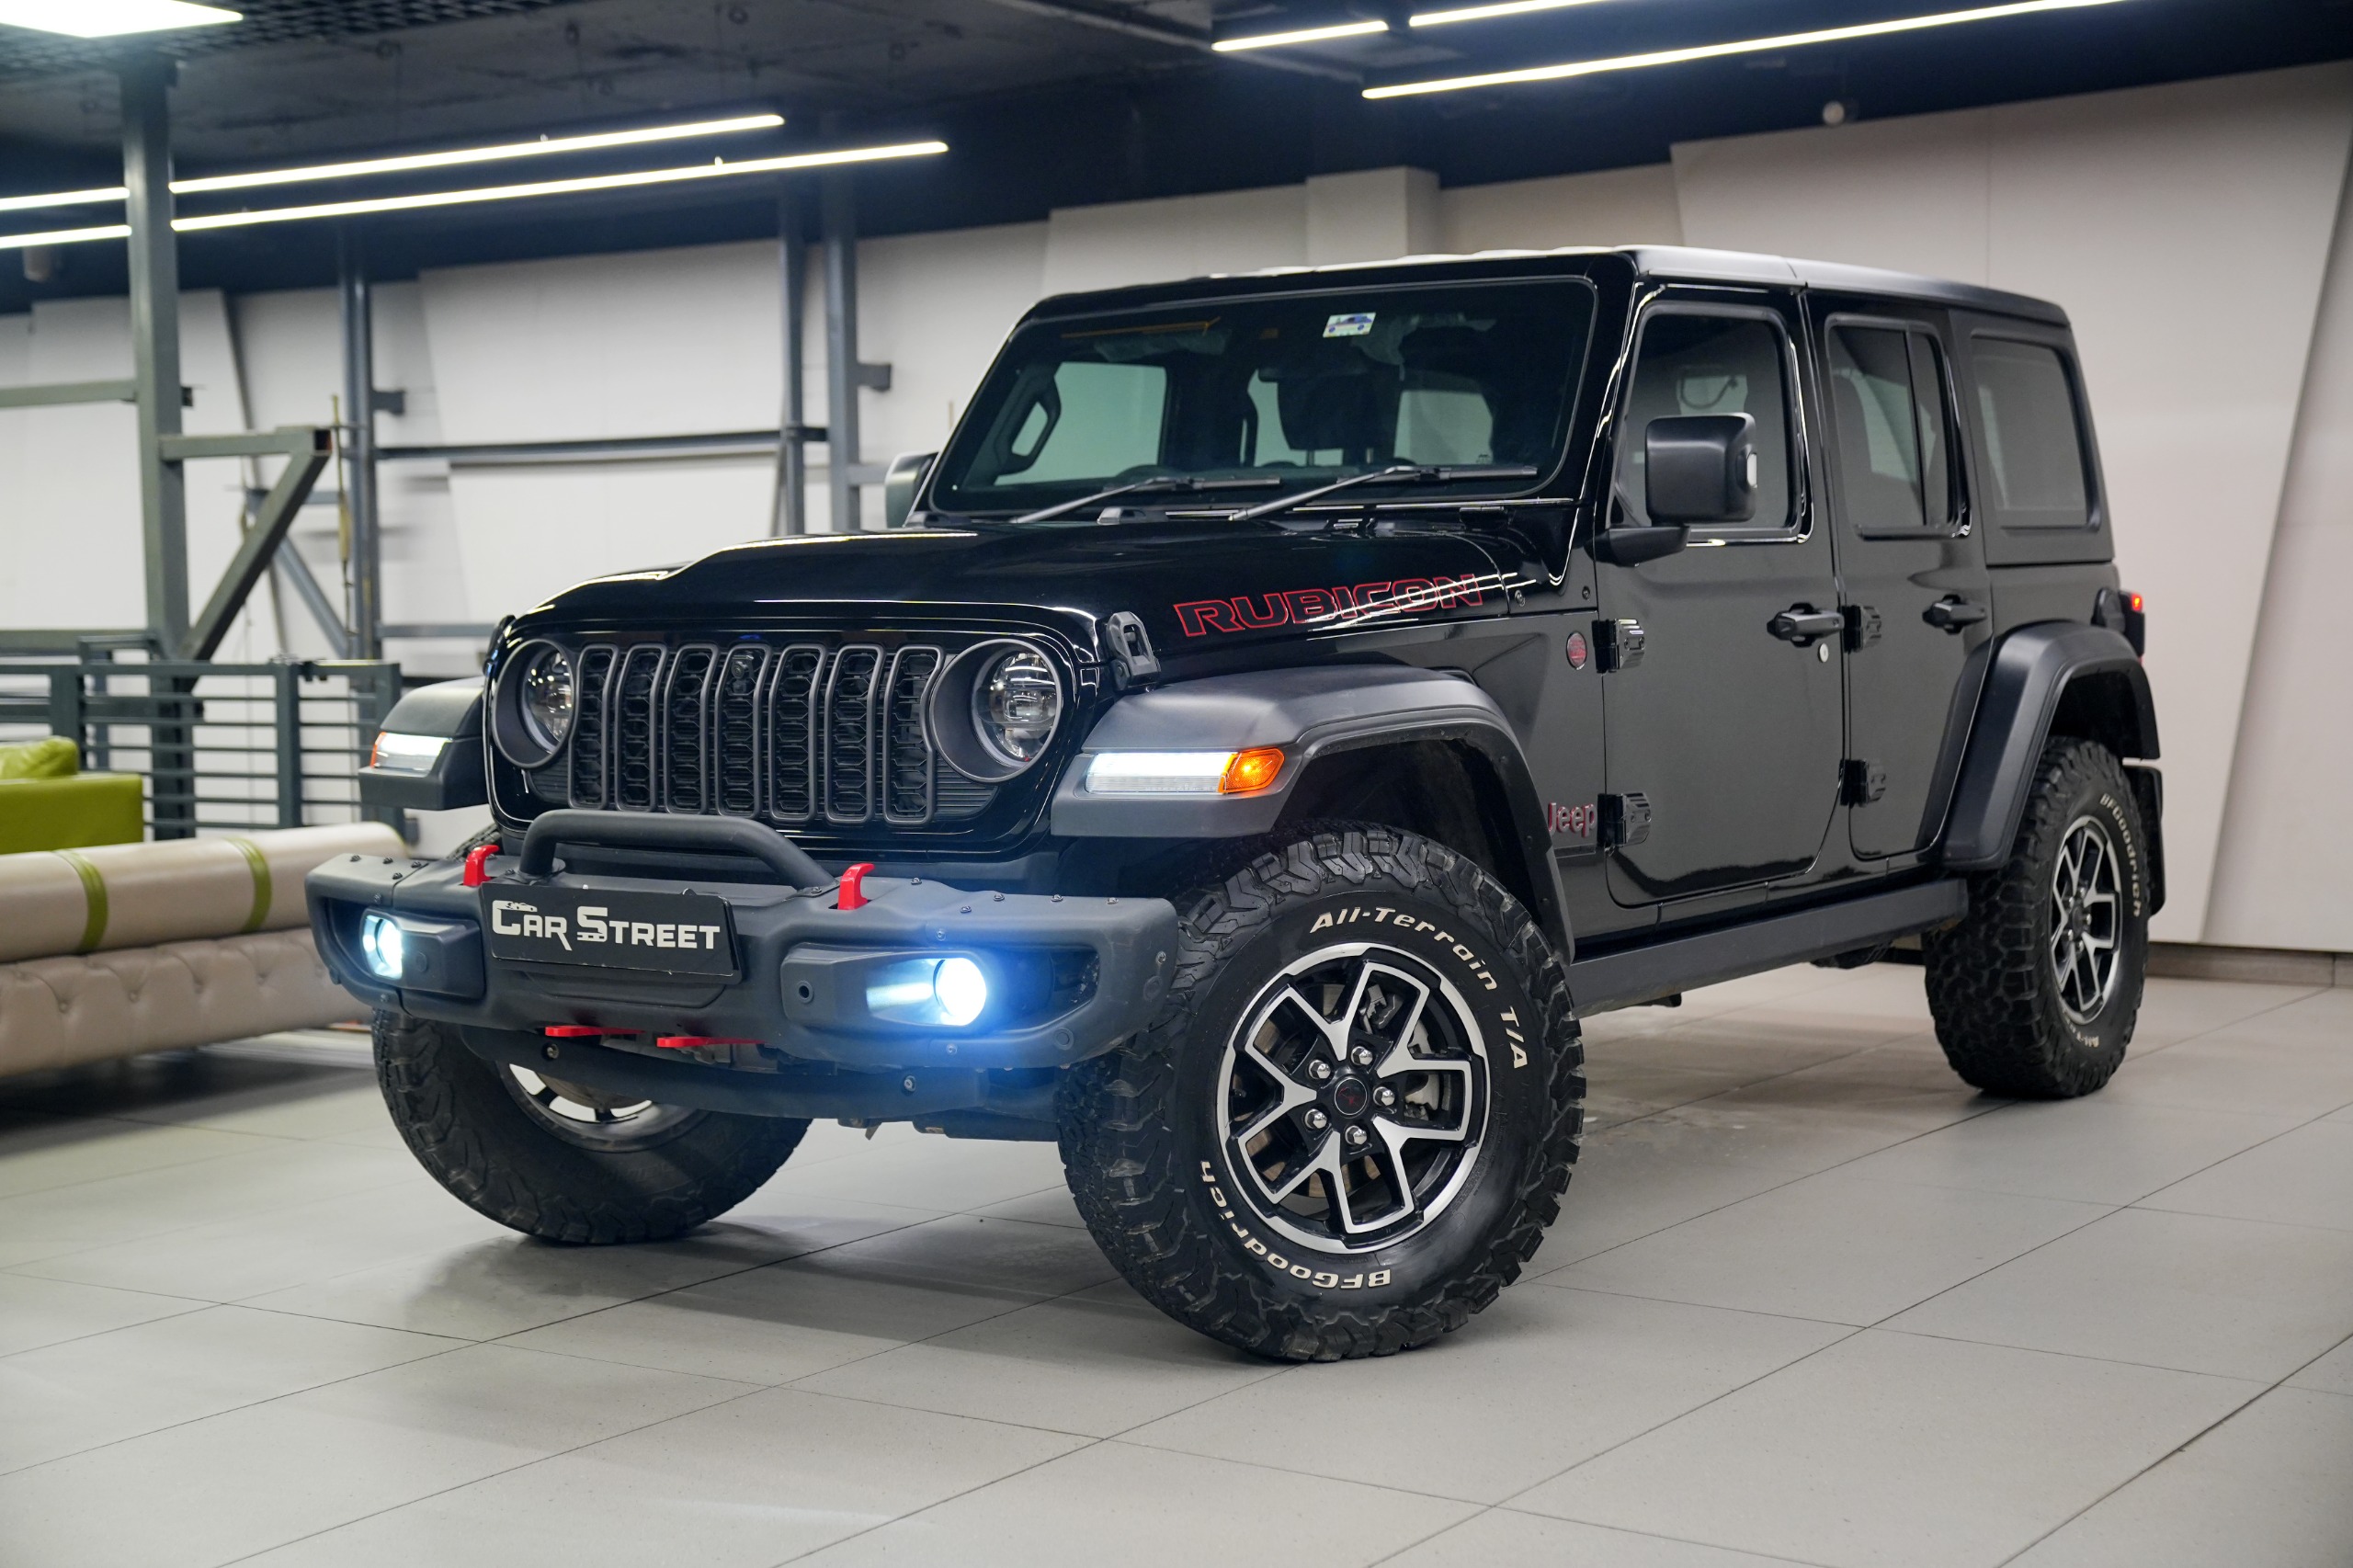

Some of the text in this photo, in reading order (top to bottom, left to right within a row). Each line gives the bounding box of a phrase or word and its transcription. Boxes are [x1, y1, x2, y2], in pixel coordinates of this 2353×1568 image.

[1174, 574, 1483, 637] RUBICON
[1548, 802, 1597, 837] Jeep
[492, 900, 720, 951] CAR STREET
[1310, 906, 1528, 1069] All-Terrain T/A
[1200, 1161, 1391, 1290] BFGoodrich
